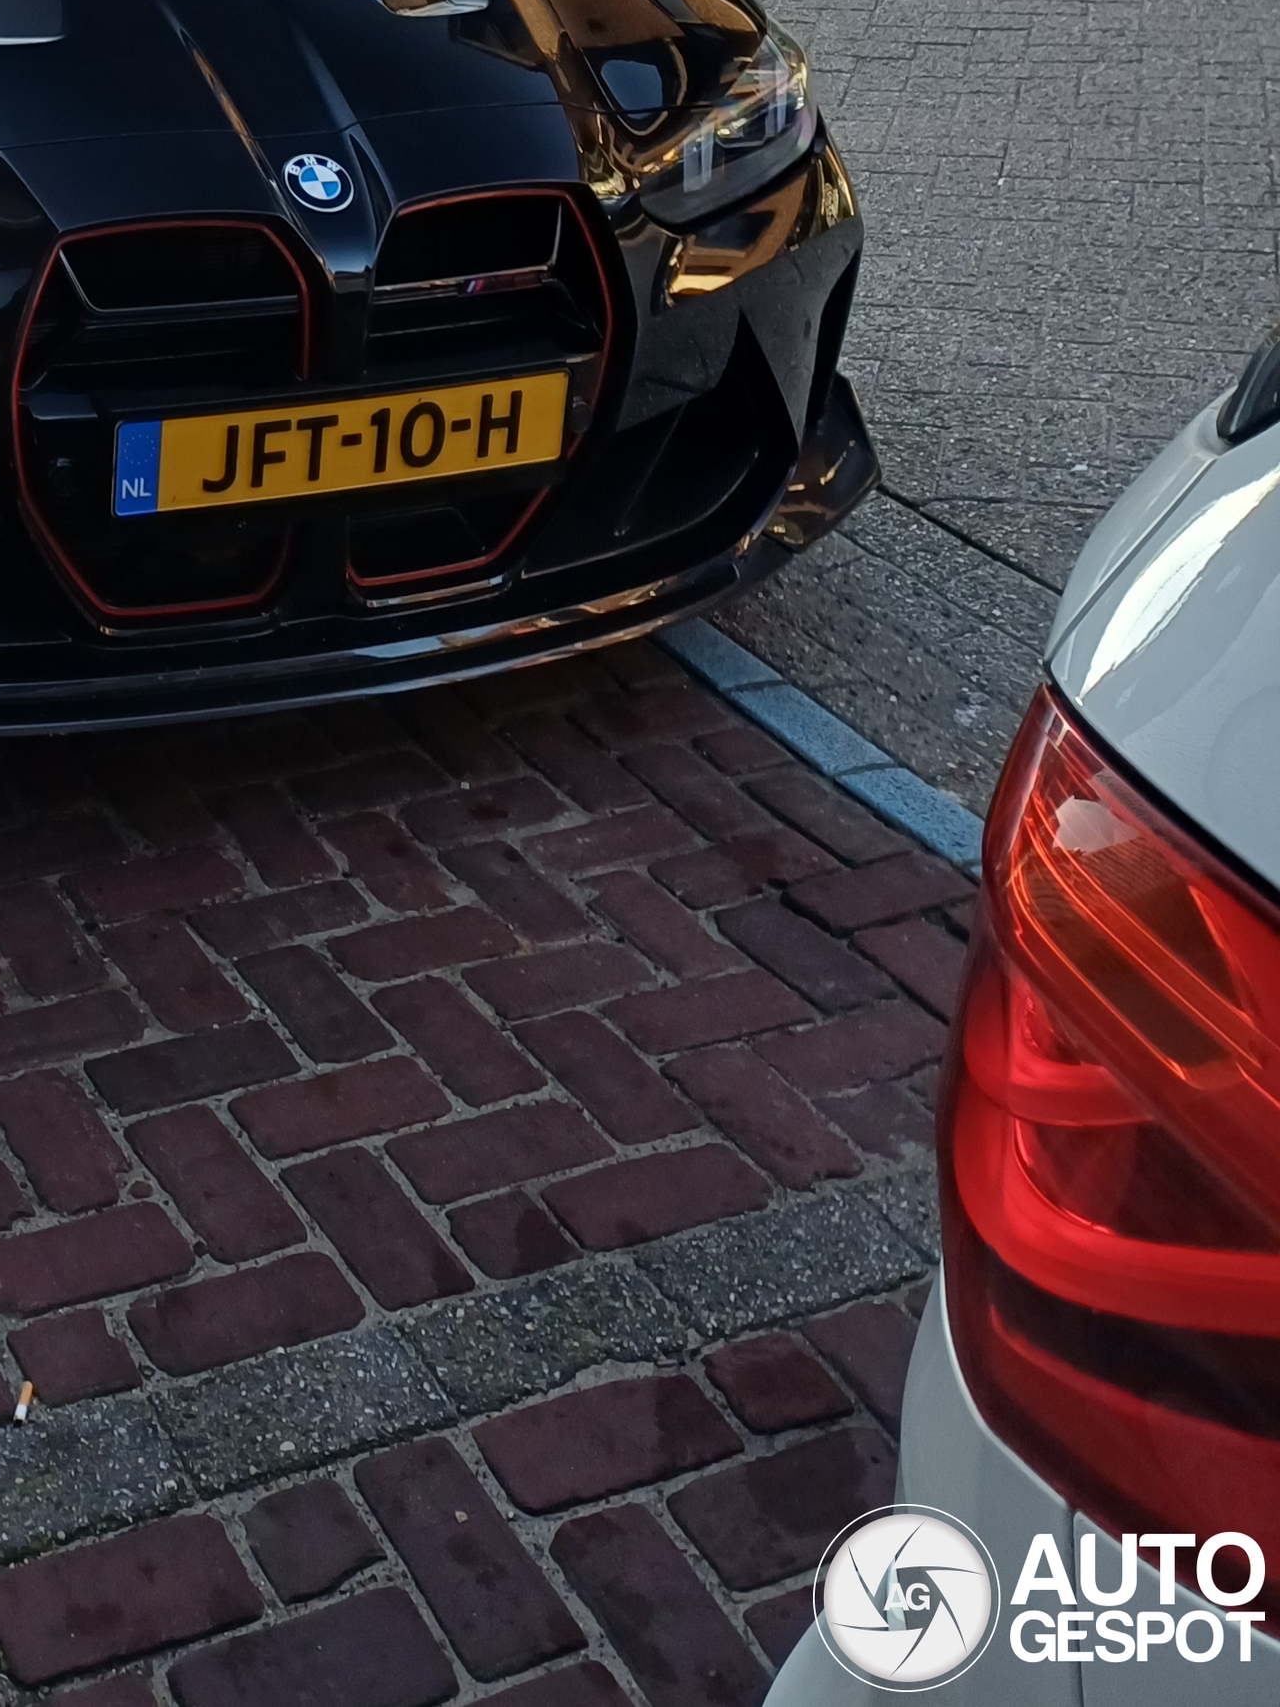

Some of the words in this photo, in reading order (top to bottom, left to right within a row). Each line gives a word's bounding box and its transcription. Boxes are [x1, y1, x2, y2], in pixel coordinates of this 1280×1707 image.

[288, 155, 341, 176] BMW
[202, 390, 523, 493] JFT-10-H
[121, 478, 152, 499] NL
